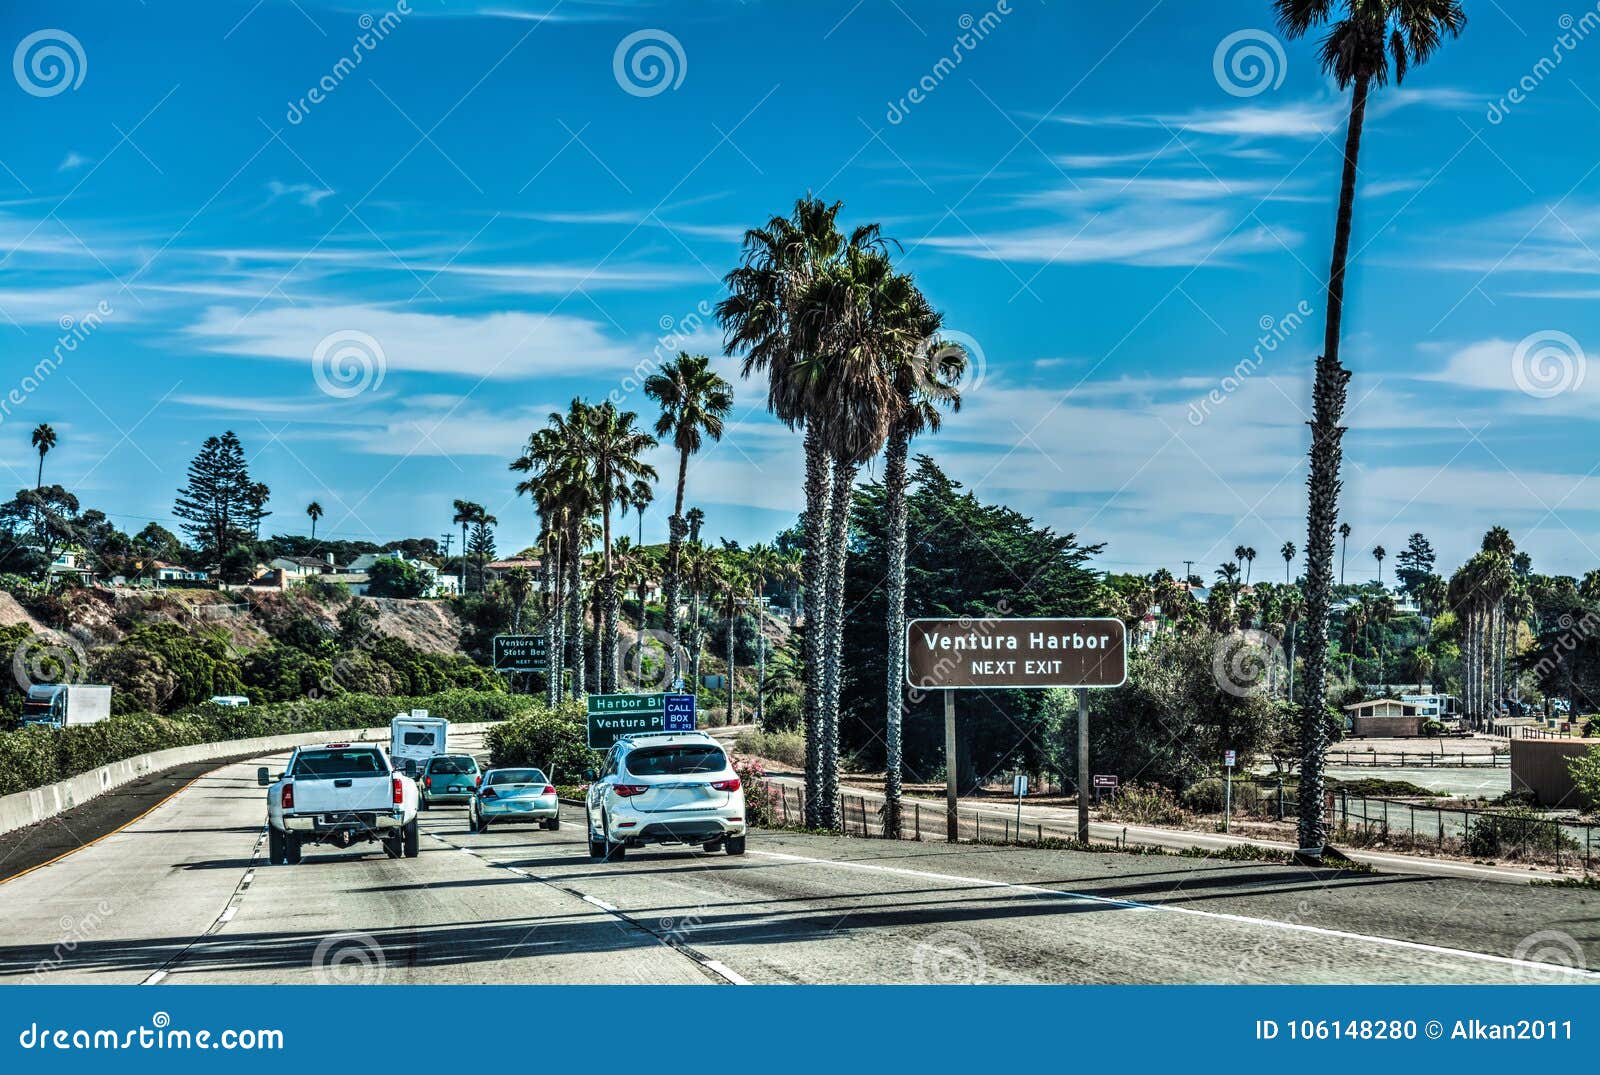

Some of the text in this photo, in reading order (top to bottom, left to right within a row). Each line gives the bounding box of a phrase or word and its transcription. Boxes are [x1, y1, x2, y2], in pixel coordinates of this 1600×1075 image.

[499, 639, 534, 647] Ventura
[924, 632, 1109, 650] Ventura Harbor
[530, 648, 546, 656] Bea
[972, 661, 1062, 675] NEXT EXIT
[597, 697, 663, 709] Harbor Bl
[667, 704, 691, 712] CALL
[596, 718, 646, 728] Ventura
[651, 716, 664, 726] Pi
[670, 714, 689, 722] BOX
